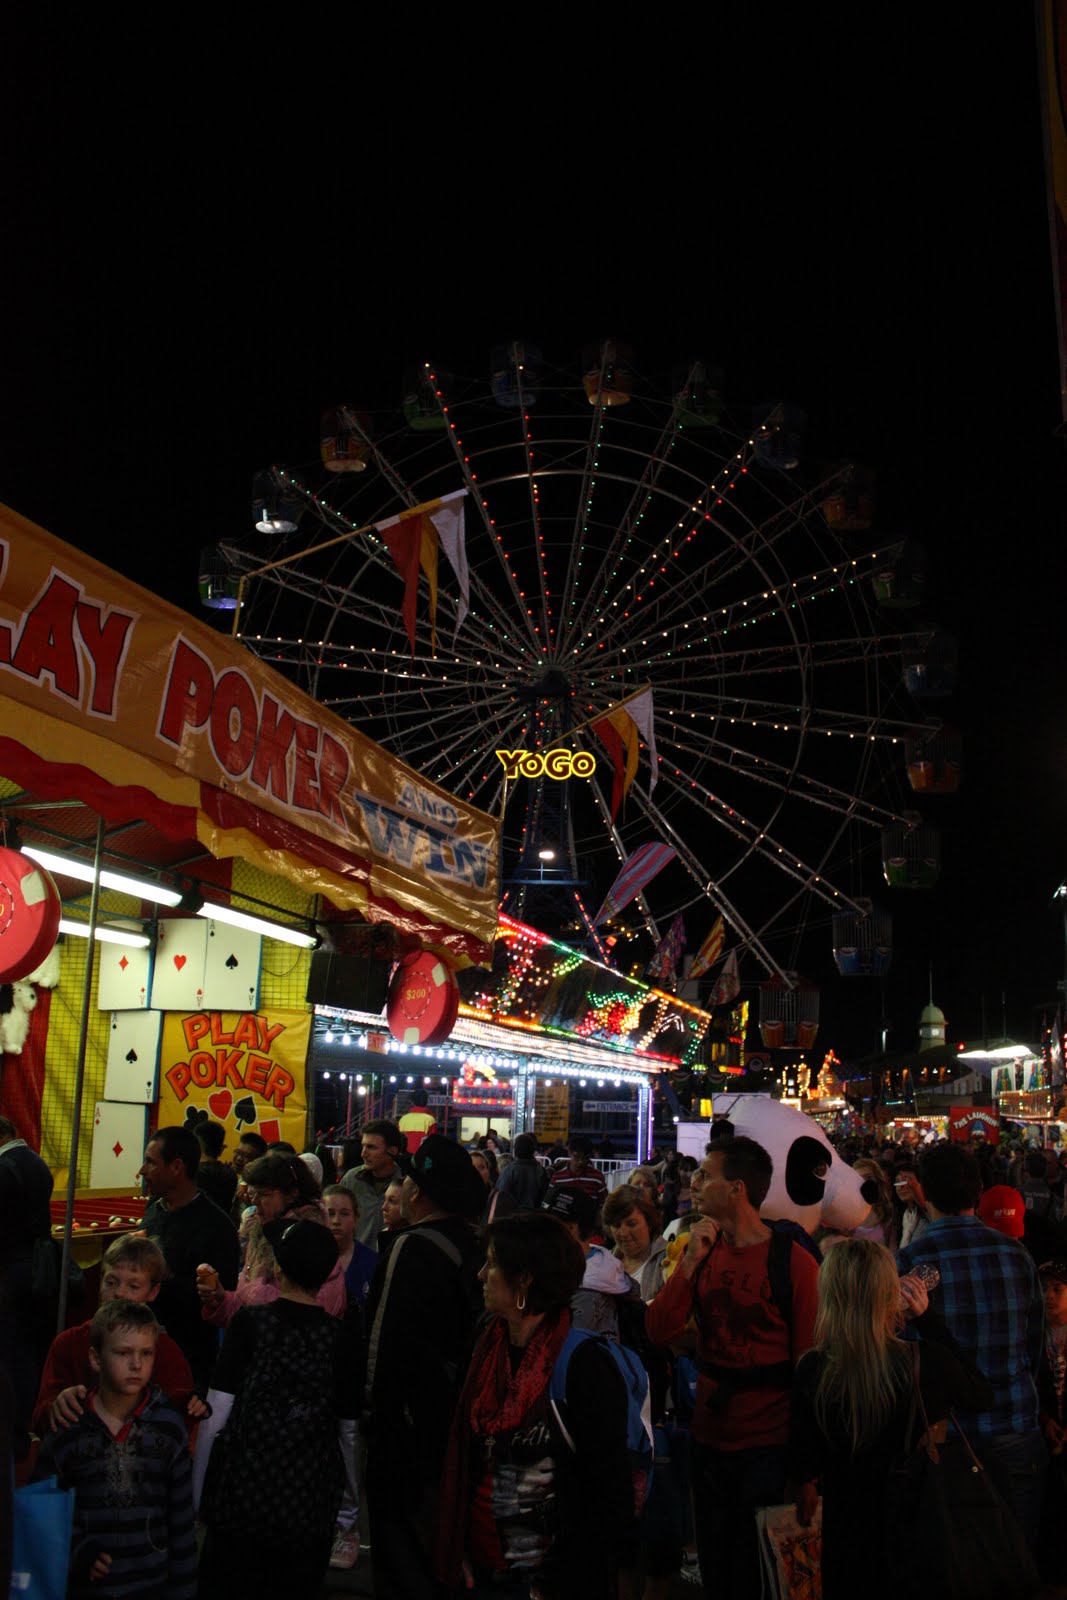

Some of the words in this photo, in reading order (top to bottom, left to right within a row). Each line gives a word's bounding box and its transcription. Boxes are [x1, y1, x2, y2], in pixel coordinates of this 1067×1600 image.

[156, 633, 350, 836] POKER
[495, 748, 596, 780] YOGO
[396, 784, 459, 831] AND
[353, 787, 492, 892] WIN
[406, 988, 426, 1001] $200
[182, 1011, 287, 1053] PLAY
[165, 1049, 295, 1112] POKER
[596, 1102, 631, 1111] ENTRANCE
[953, 1117, 968, 1129] THE
